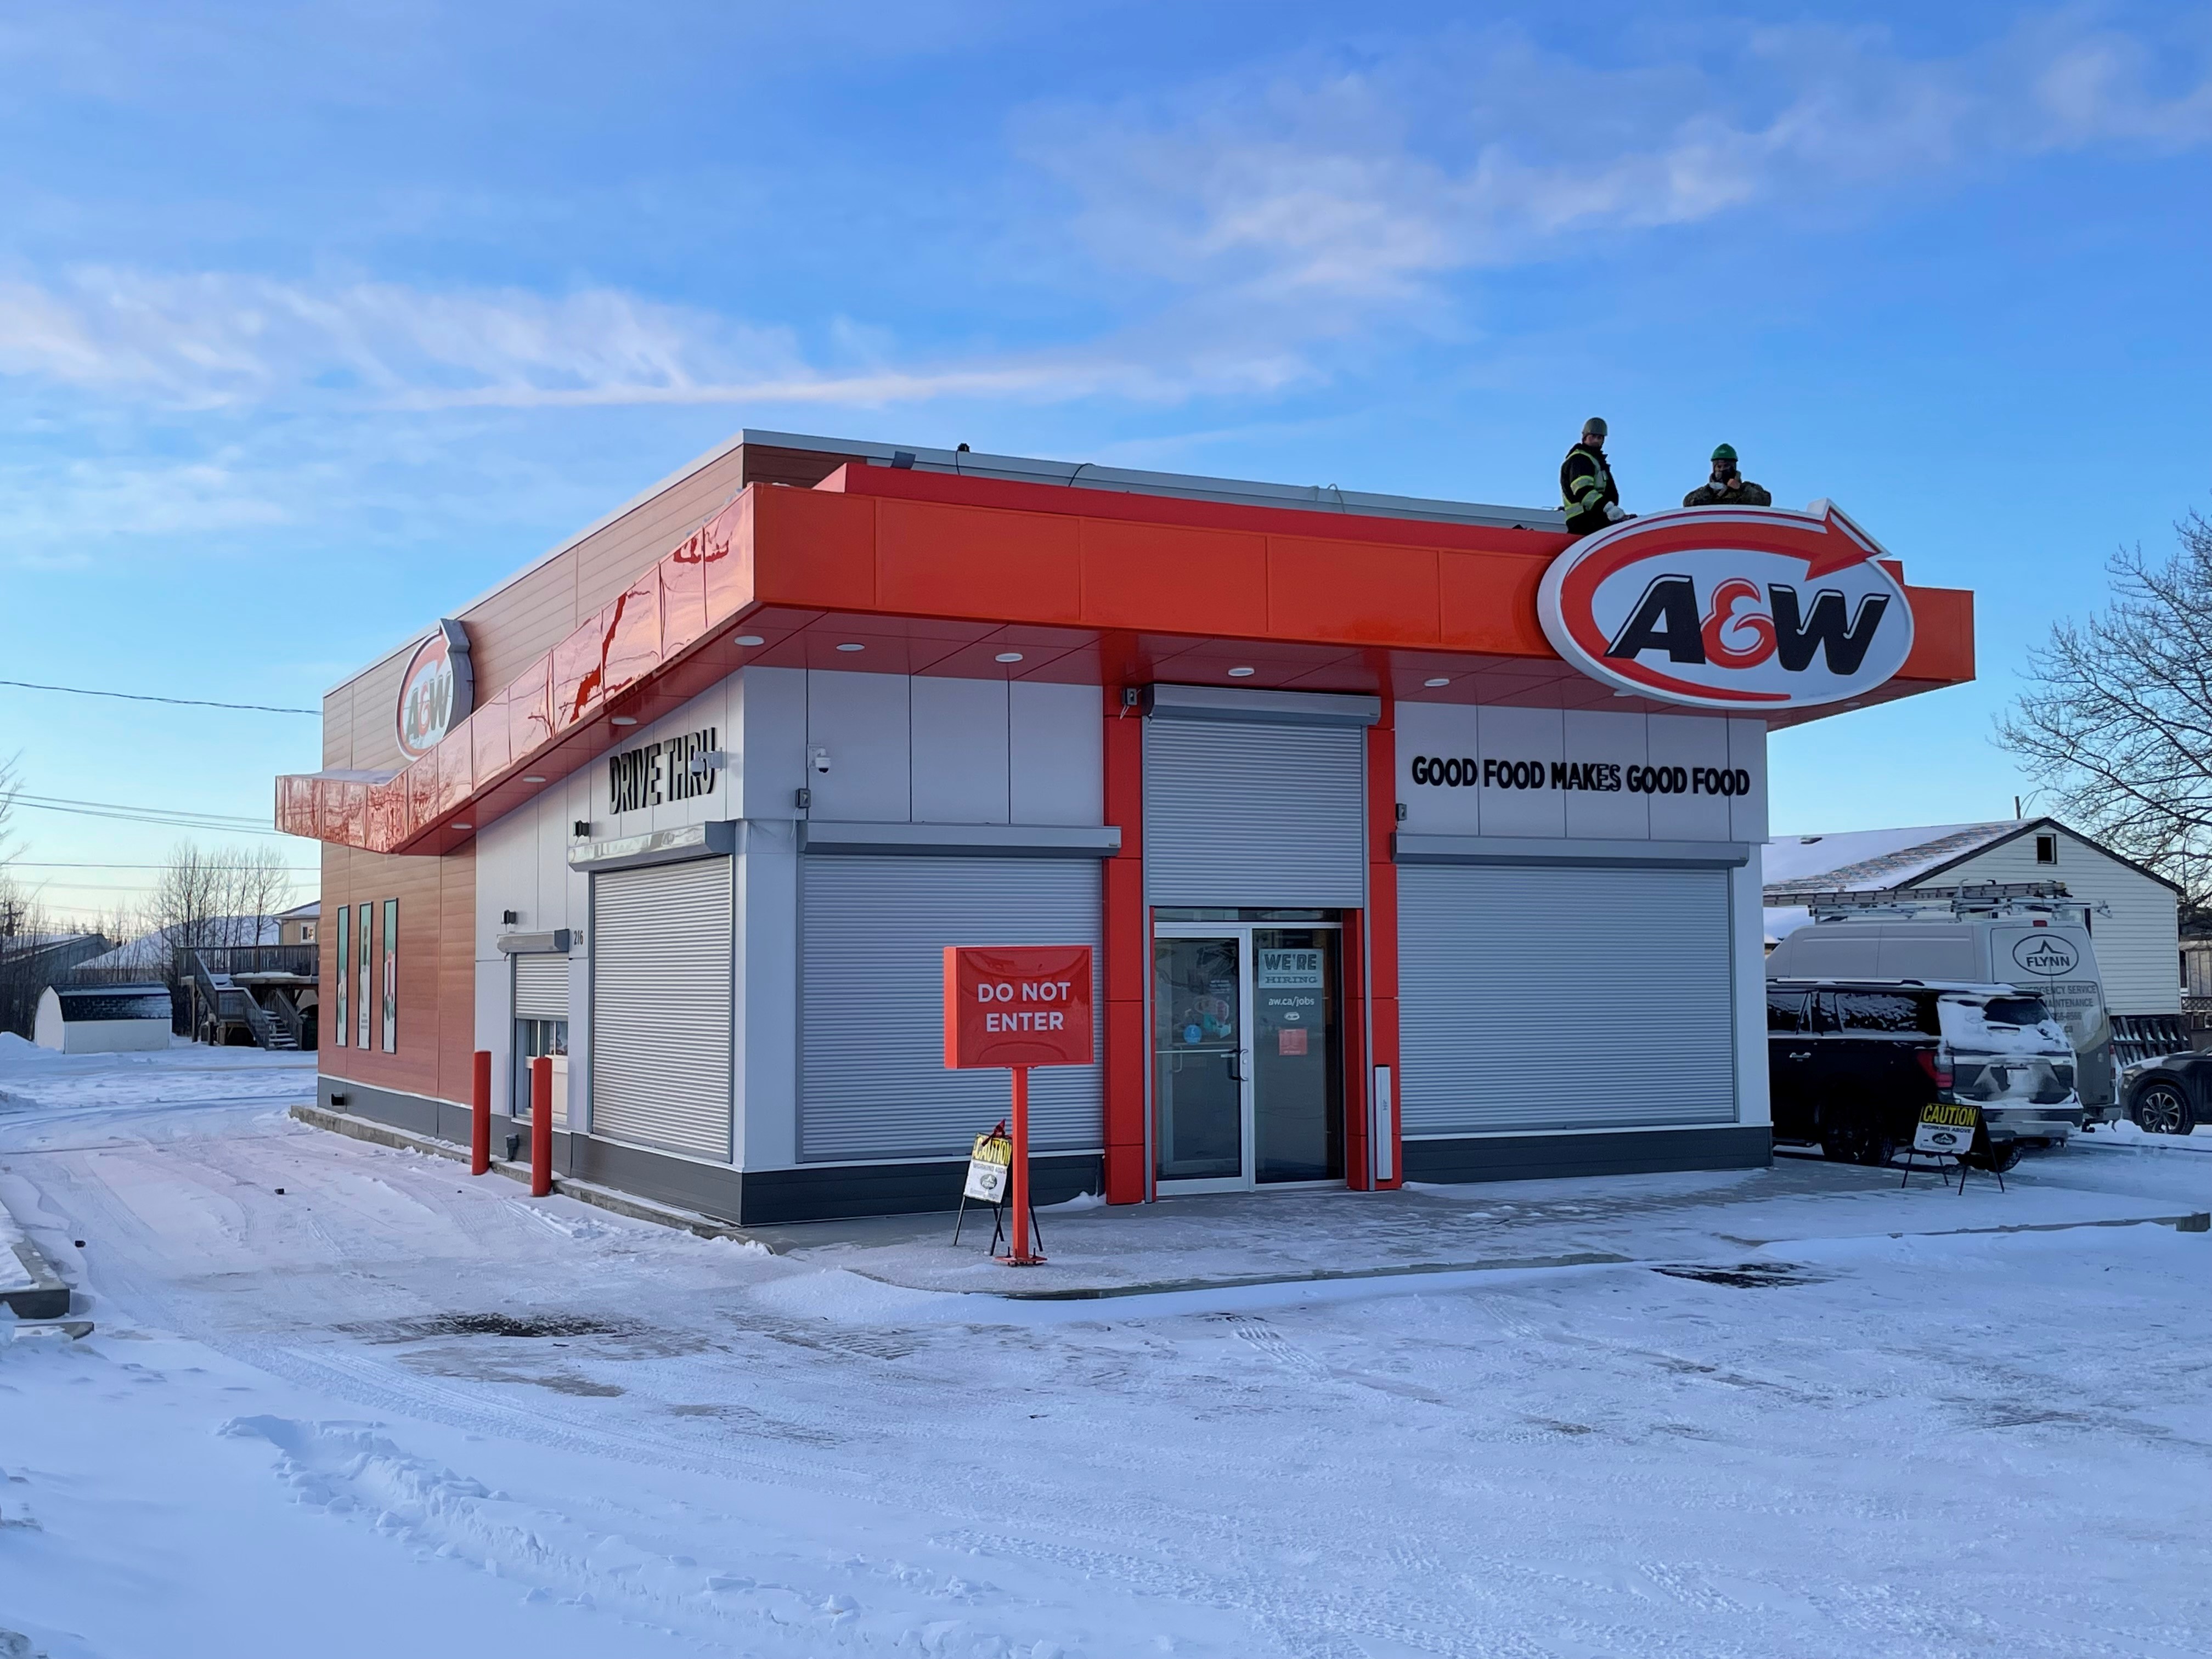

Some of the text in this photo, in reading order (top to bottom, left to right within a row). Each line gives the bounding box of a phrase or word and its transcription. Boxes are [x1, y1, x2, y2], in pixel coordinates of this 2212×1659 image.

[1603, 573, 1891, 675] A&W
[406, 670, 452, 742] A&W
[610, 727, 716, 815] DRIVE THRU
[1412, 756, 1751, 797] GOOD FOOD MAKES GOOD FOOD
[573, 930, 584, 945] 216
[1264, 953, 1317, 970] WE'RE
[2026, 956, 2070, 967] FLYNN
[978, 981, 1071, 1003] DO NOT
[2067, 985, 2097, 994] SERVICE
[1268, 996, 1315, 1007] aw.ca/jobs
[986, 1011, 1064, 1032] ENTER
[1922, 1104, 1977, 1126] CAUTION
[974, 1136, 1012, 1165] CAUTION
